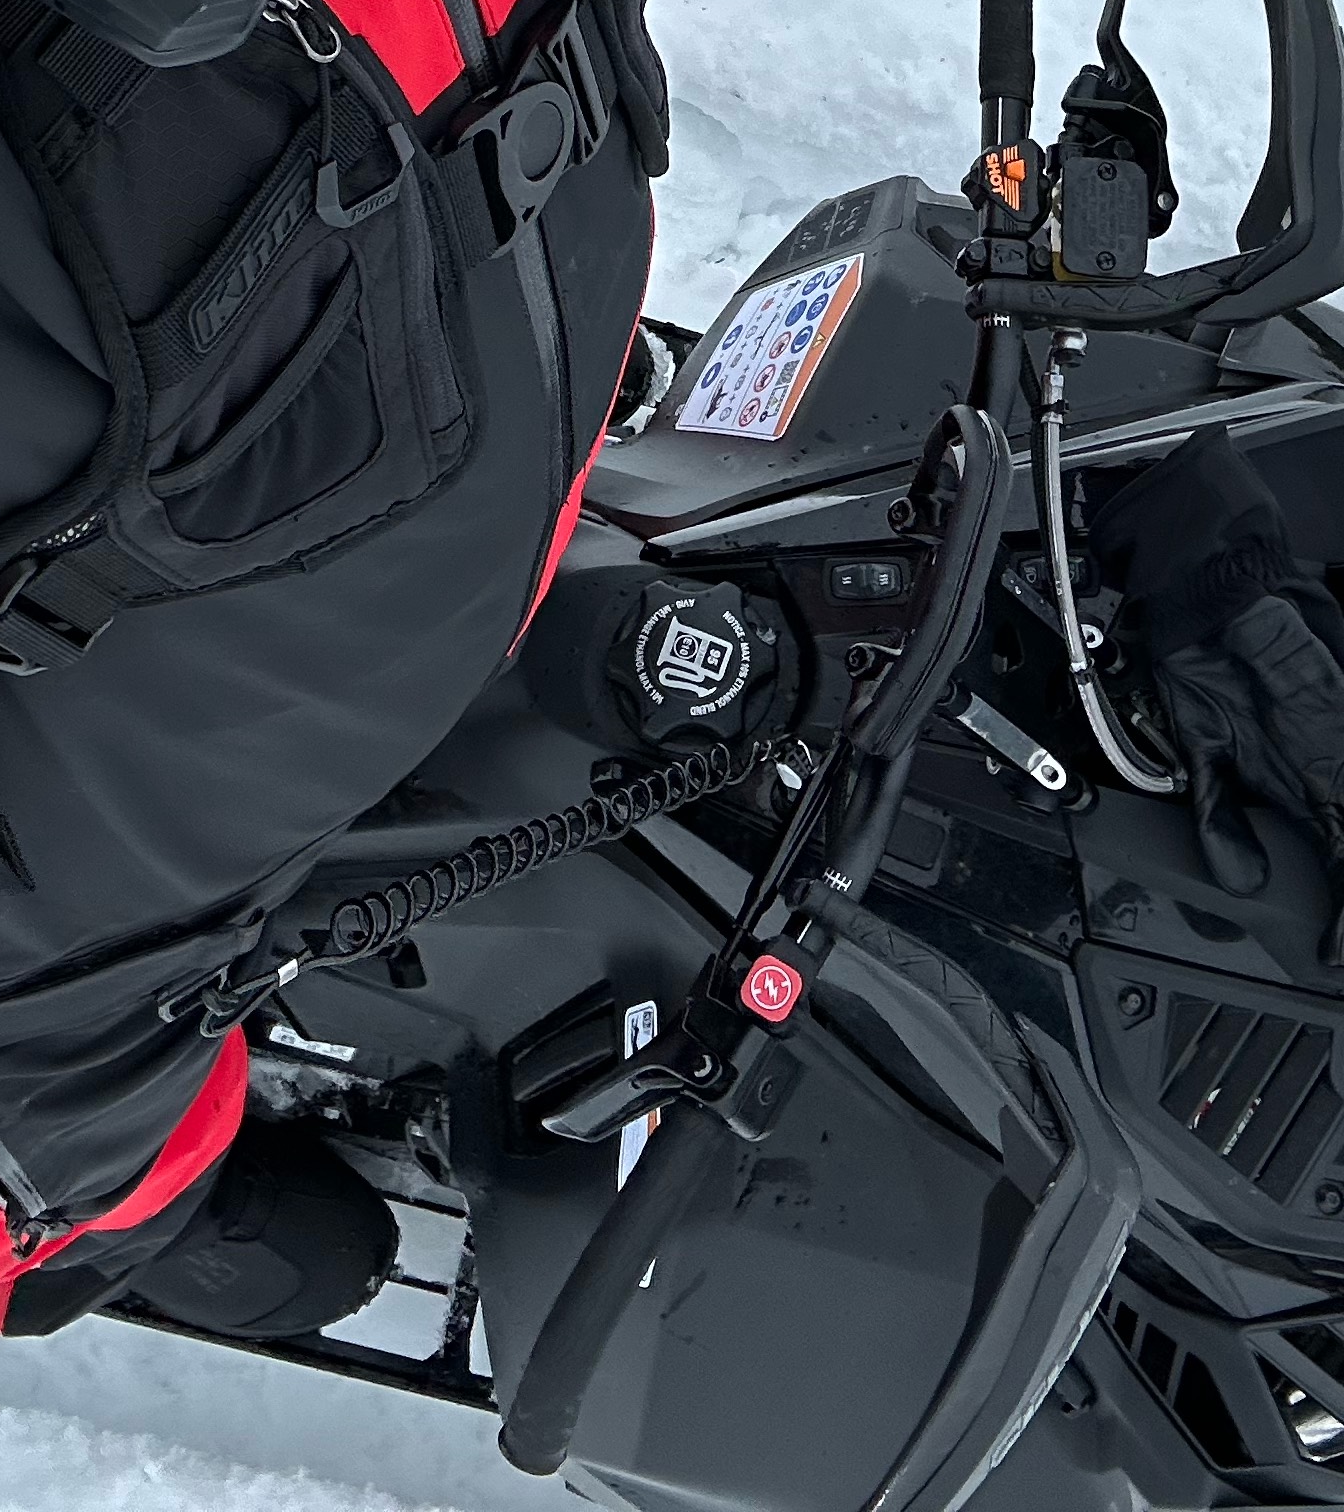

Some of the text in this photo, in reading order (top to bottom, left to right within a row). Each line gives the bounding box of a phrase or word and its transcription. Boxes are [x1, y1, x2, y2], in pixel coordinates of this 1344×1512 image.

[985, 152, 1005, 197] SHOT
[681, 638, 693, 656] E10
[707, 648, 721, 666] 95
